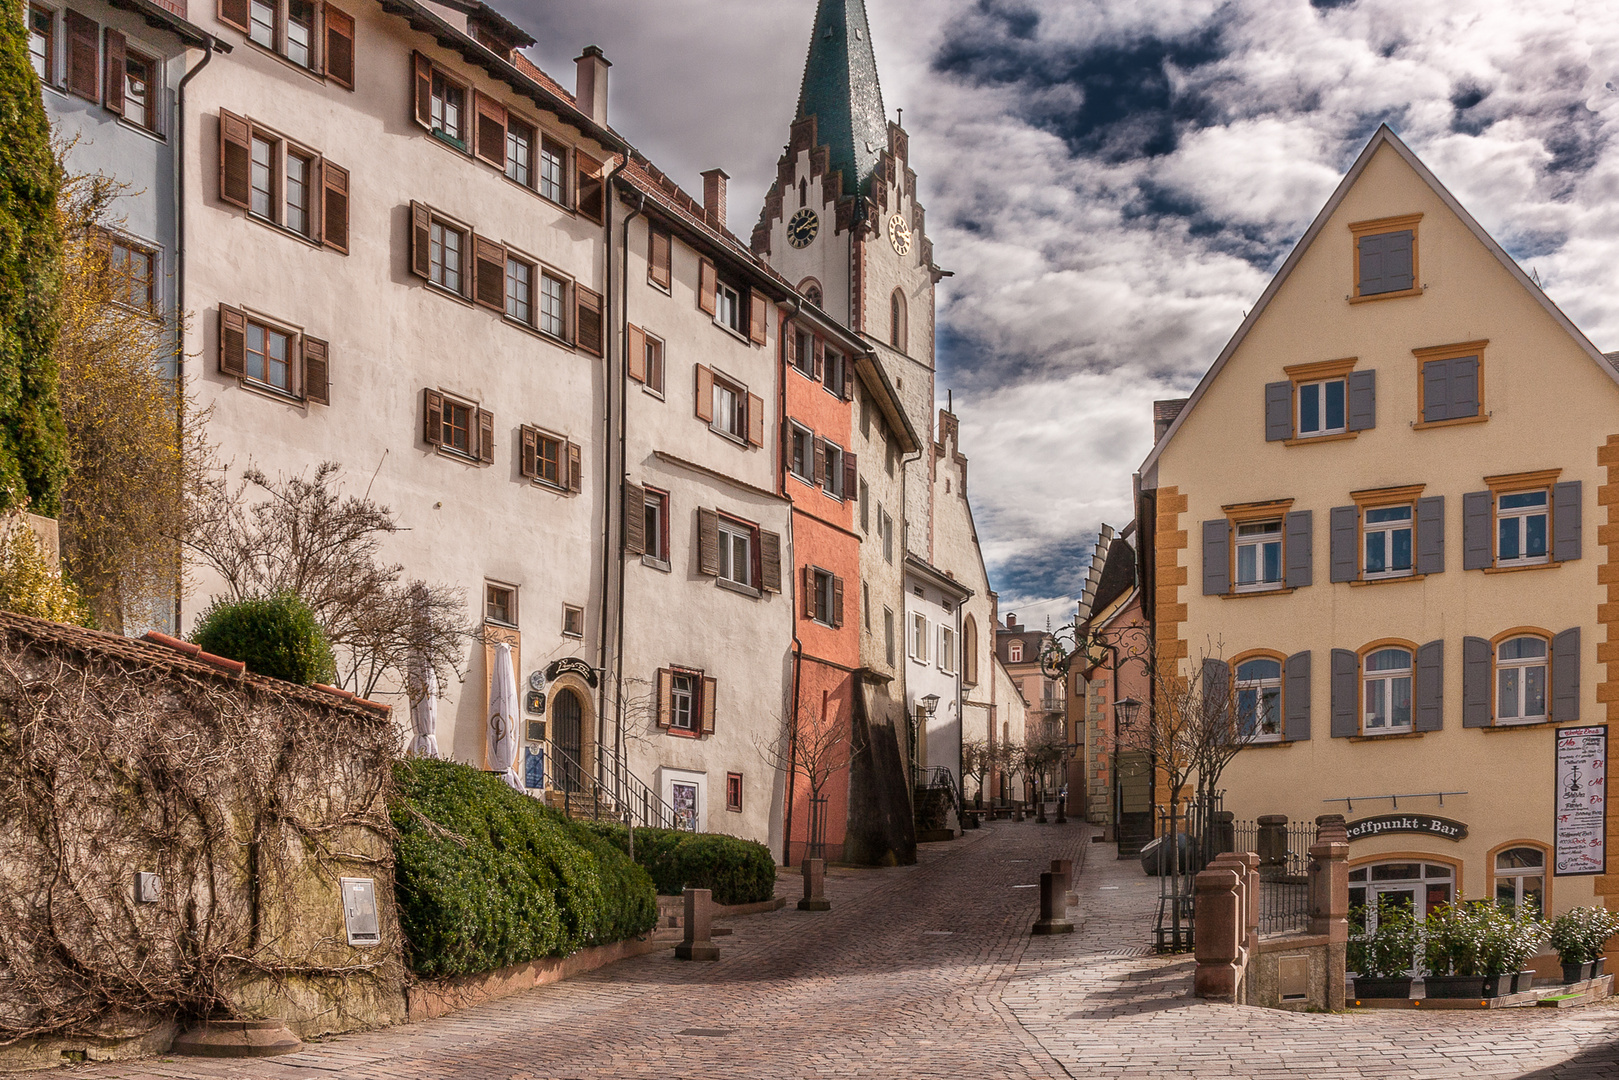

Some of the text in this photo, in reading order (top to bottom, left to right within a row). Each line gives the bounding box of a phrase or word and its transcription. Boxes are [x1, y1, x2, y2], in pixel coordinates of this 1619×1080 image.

[1590, 794, 1602, 804] Do
[1346, 817, 1419, 838] reffpunkt
[1429, 819, 1459, 836] Bar
